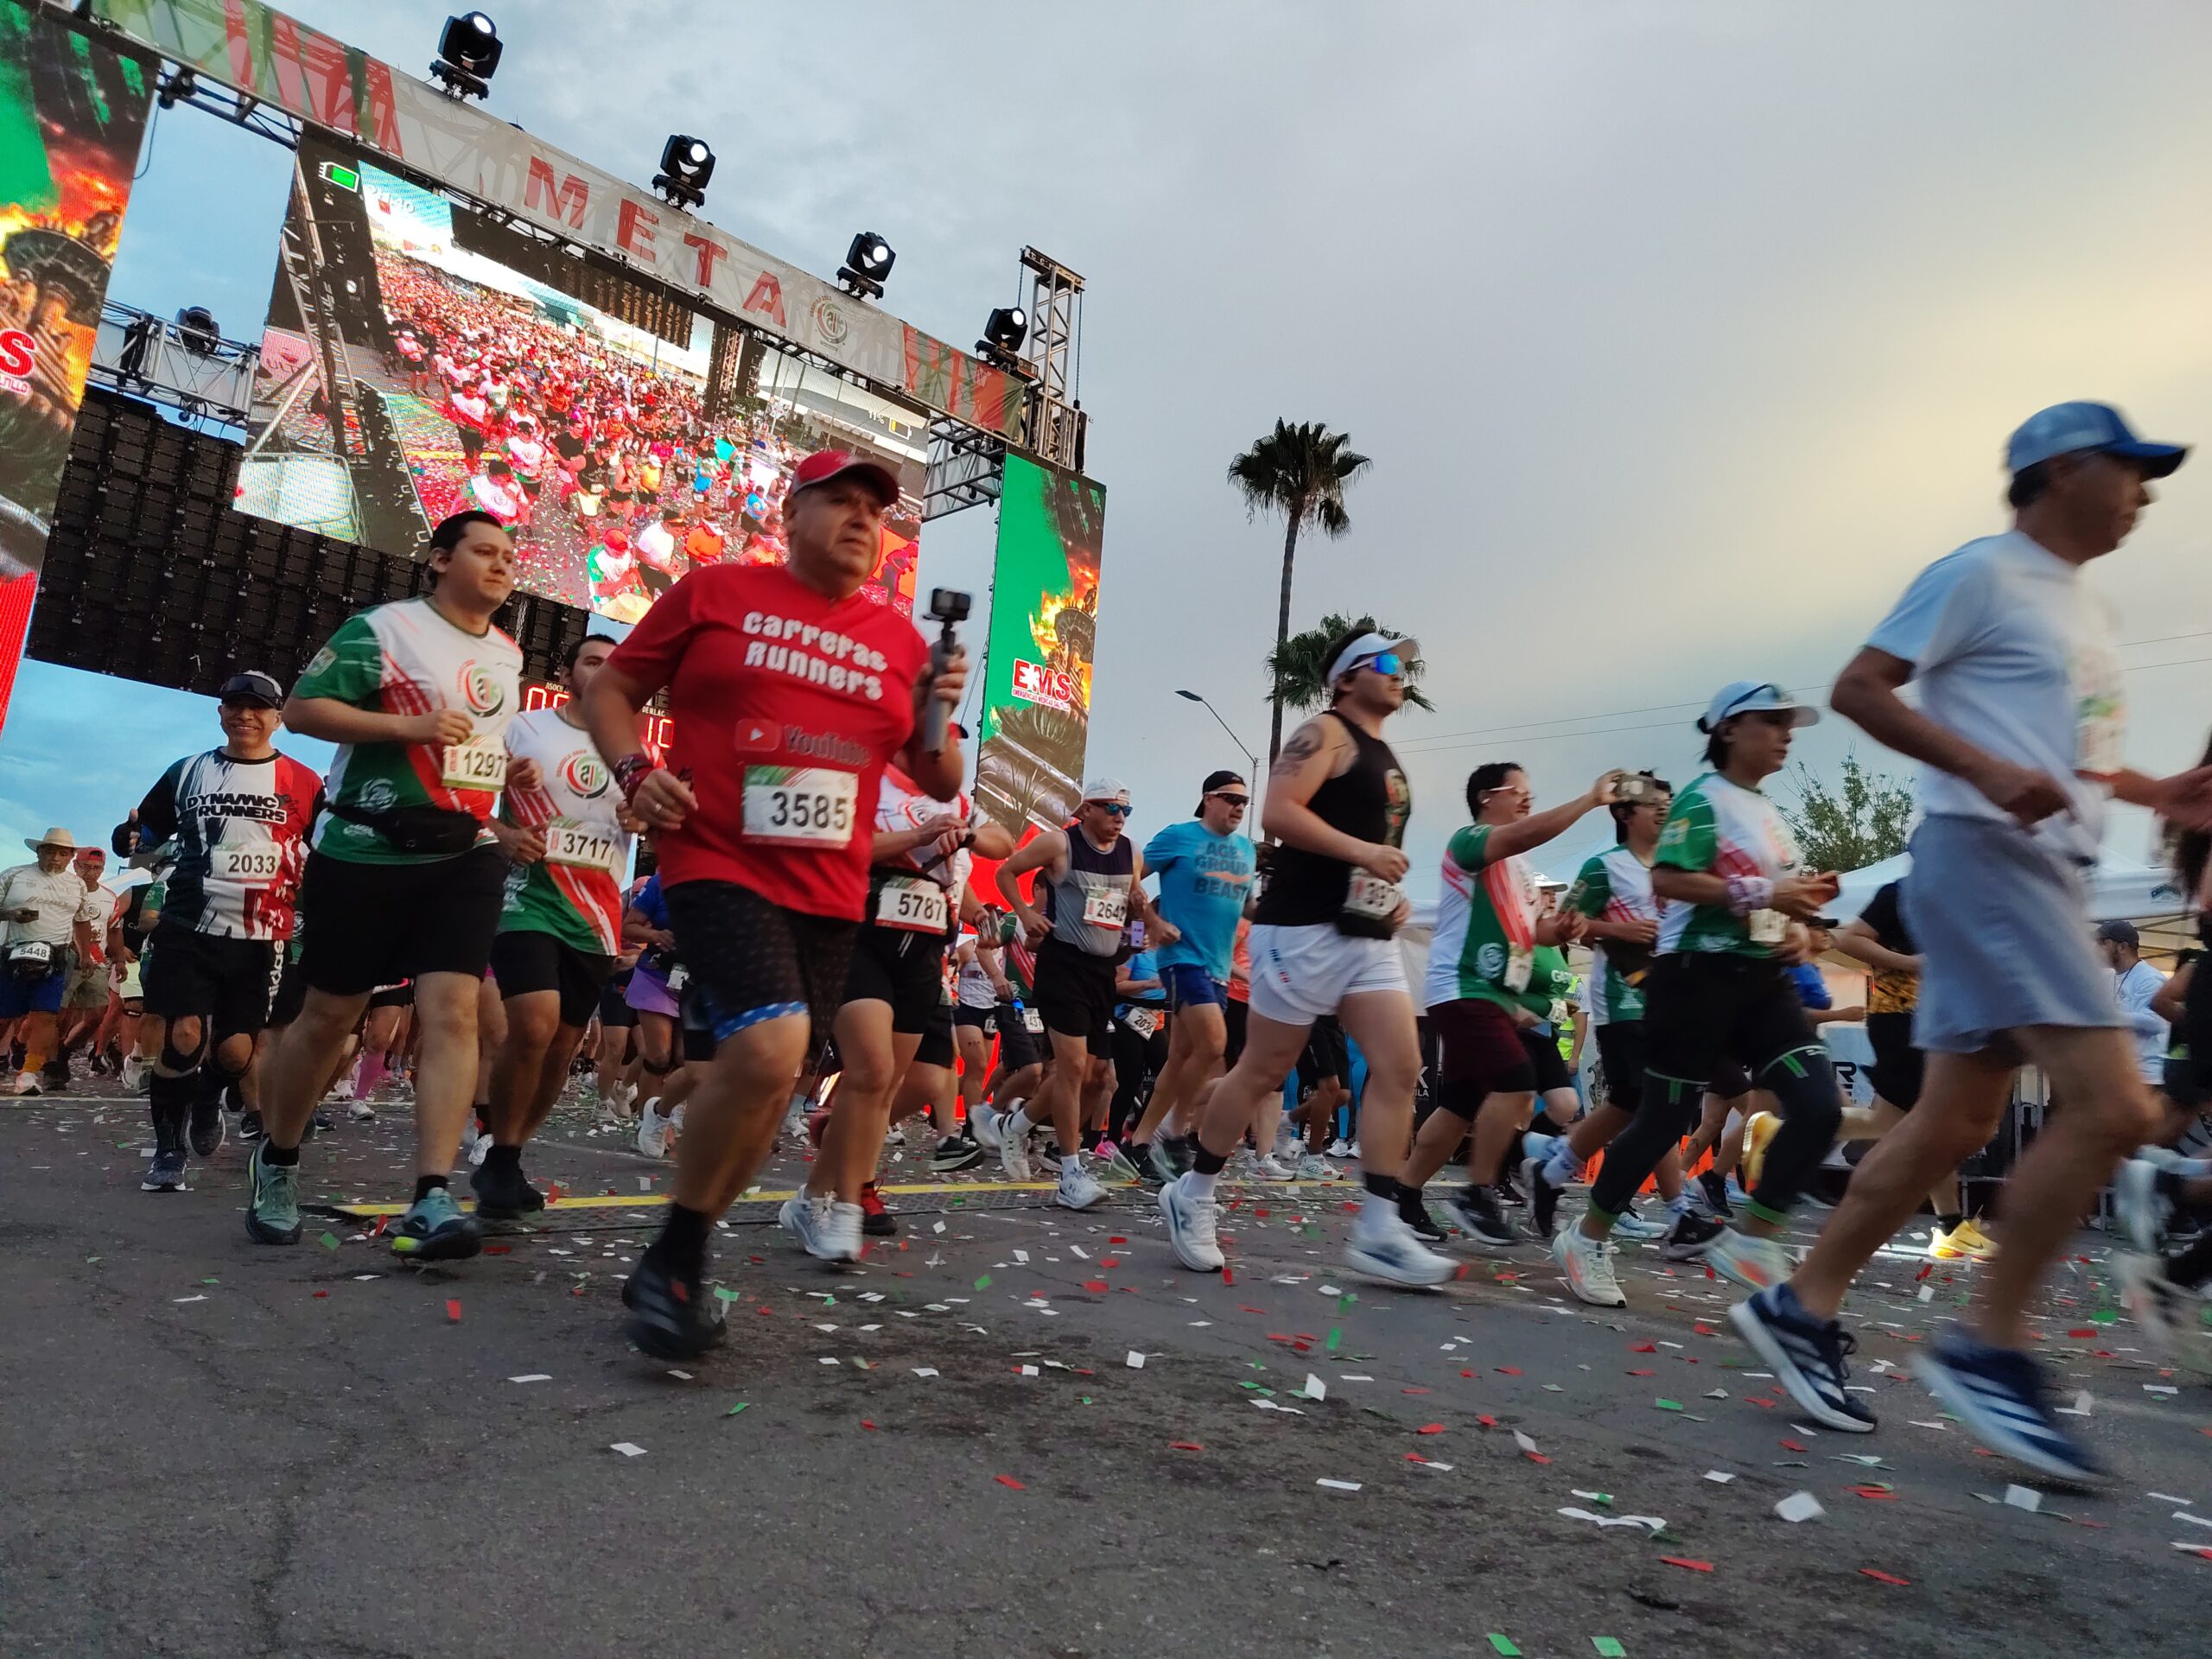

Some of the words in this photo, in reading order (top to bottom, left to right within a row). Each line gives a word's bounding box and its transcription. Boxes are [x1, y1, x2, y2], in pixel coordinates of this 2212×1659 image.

[524, 156, 787, 328] META
[868, 410, 885, 424] 11%
[742, 611, 888, 672] Carreras
[743, 639, 884, 702] Runners
[1013, 658, 1071, 702] EMS
[784, 724, 872, 767] YouTube
[463, 749, 505, 779] 1297
[186, 792, 278, 810] DYNAMIC
[198, 804, 286, 823] RUNNERS
[771, 791, 848, 830] 3585
[563, 832, 611, 861] 3717
[228, 854, 276, 874] 2033
[898, 892, 944, 921] 5787
[20, 946, 48, 958] 5448
